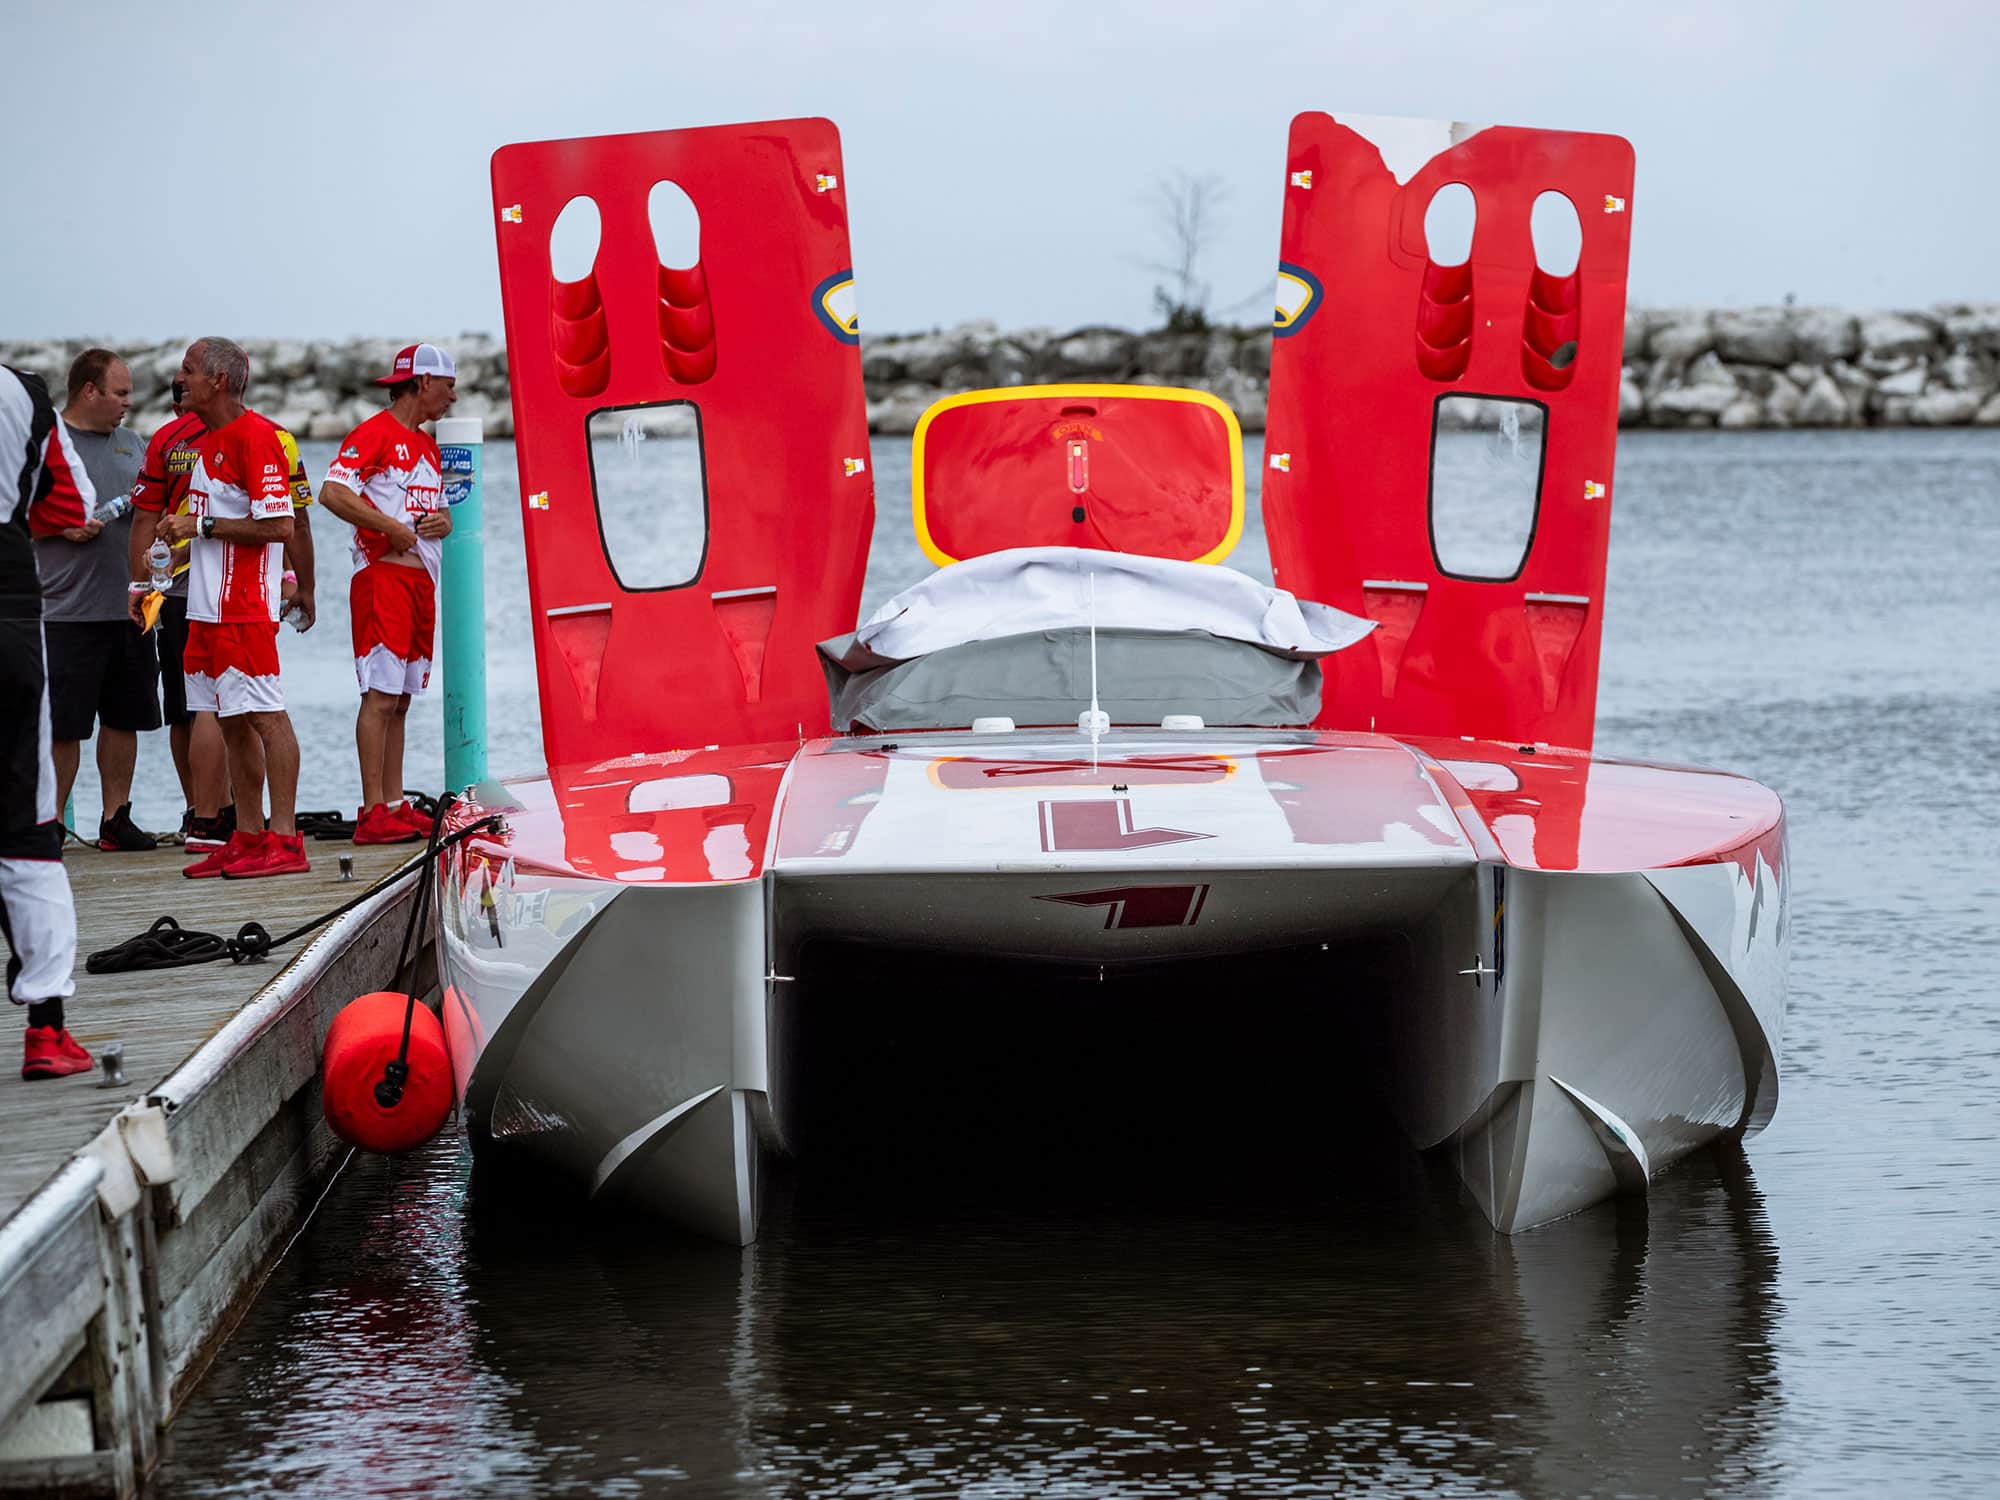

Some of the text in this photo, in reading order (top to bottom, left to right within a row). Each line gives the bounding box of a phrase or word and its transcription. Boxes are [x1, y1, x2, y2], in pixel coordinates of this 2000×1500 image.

[170, 451, 199, 462] Allen
[395, 443, 410, 461] 21
[168, 462, 188, 472] and
